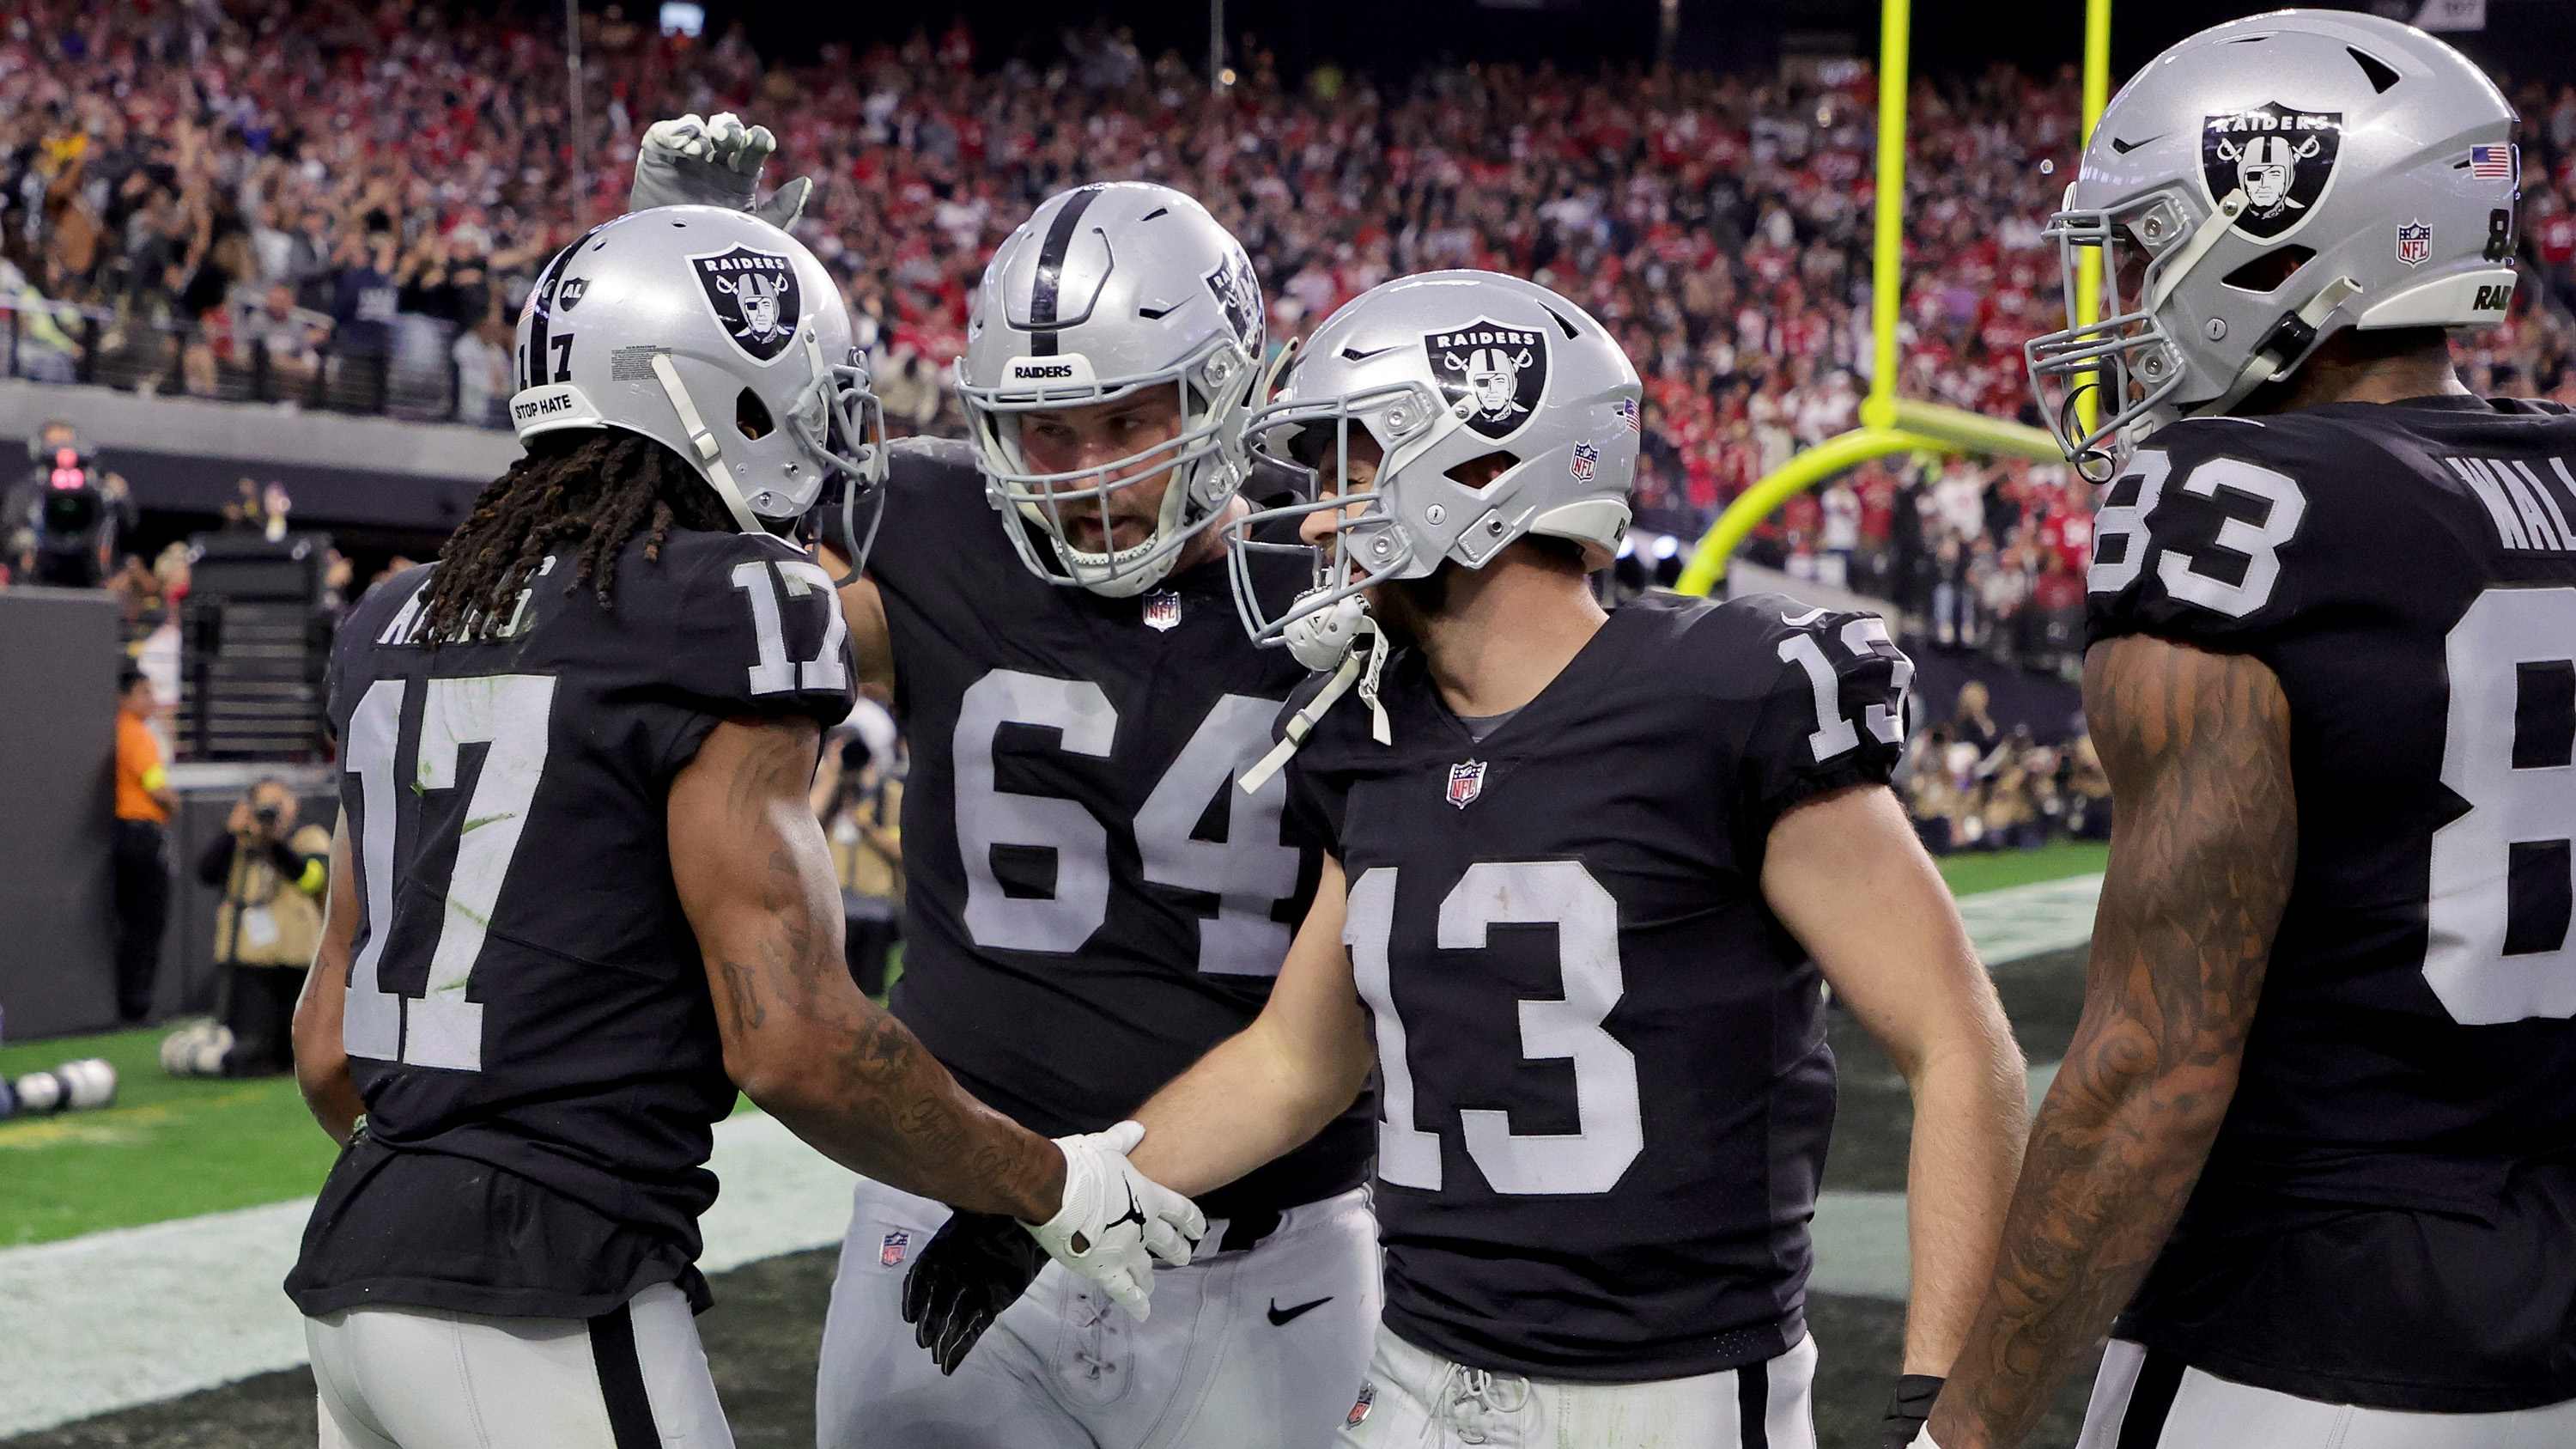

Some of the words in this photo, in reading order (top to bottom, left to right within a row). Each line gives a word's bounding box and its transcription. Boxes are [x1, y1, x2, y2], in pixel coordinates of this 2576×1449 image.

[2215, 115, 2329, 132] RAIDERS
[2402, 241, 2427, 258] NFL
[704, 257, 785, 271] RAIDERS
[561, 283, 582, 299] AL
[1437, 332, 1535, 348] RAIDERS
[1015, 365, 1072, 379] RAIDERS
[515, 402, 538, 420] STOP
[540, 394, 572, 415] HATE
[1574, 457, 1595, 477] NFL
[2087, 450, 2307, 618] 83
[732, 561, 847, 696] 17
[1777, 618, 1916, 764] 13
[1452, 779, 1474, 799] NFL
[952, 668, 1301, 977] 64
[343, 673, 557, 1072] 17
[1340, 861, 1644, 1195] 13
